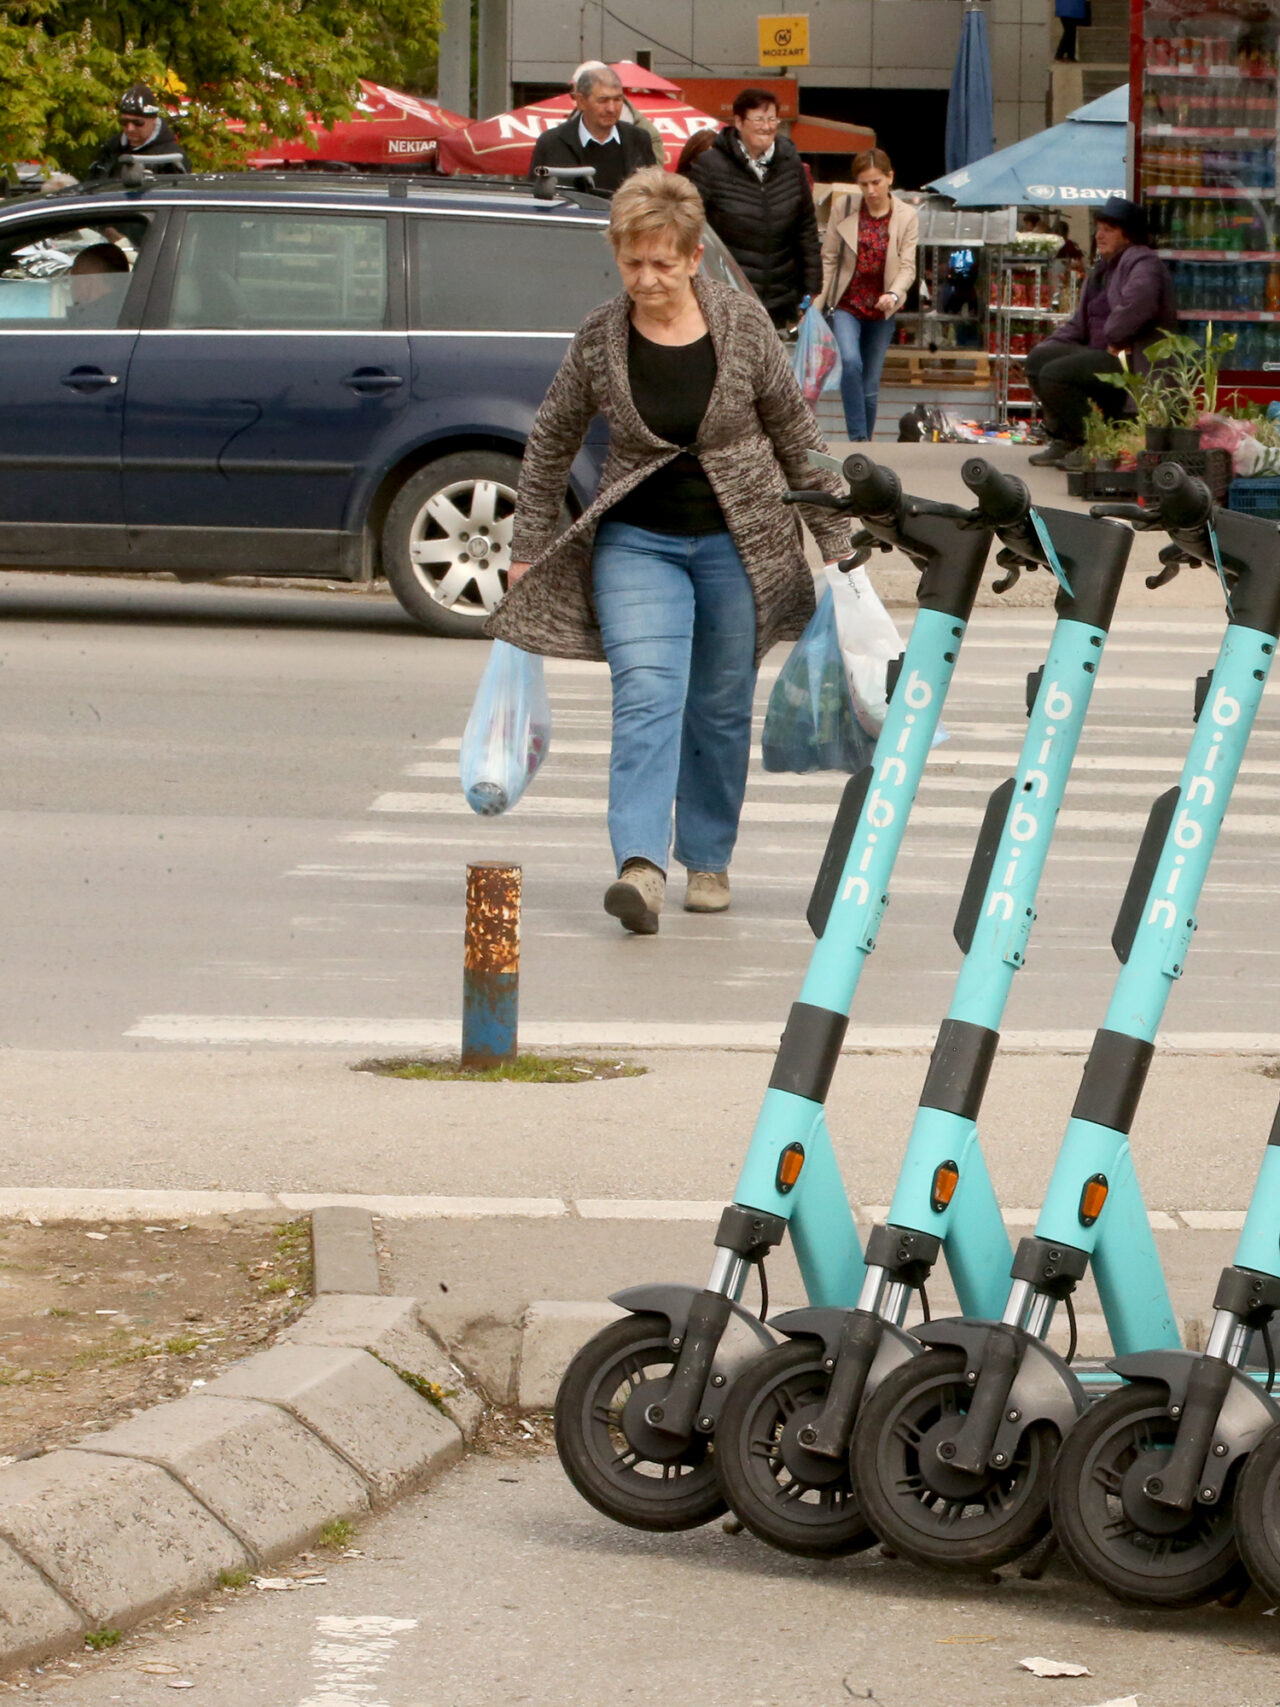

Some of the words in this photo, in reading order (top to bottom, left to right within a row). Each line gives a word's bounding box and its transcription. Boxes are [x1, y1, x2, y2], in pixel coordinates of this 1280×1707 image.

[762, 48, 805, 57] MOZZART
[388, 139, 437, 153] NEKTAR
[1059, 186, 1127, 200] Bava
[841, 670, 933, 906] binbin
[986, 681, 1073, 921] binbin
[1147, 686, 1241, 930] binbin
